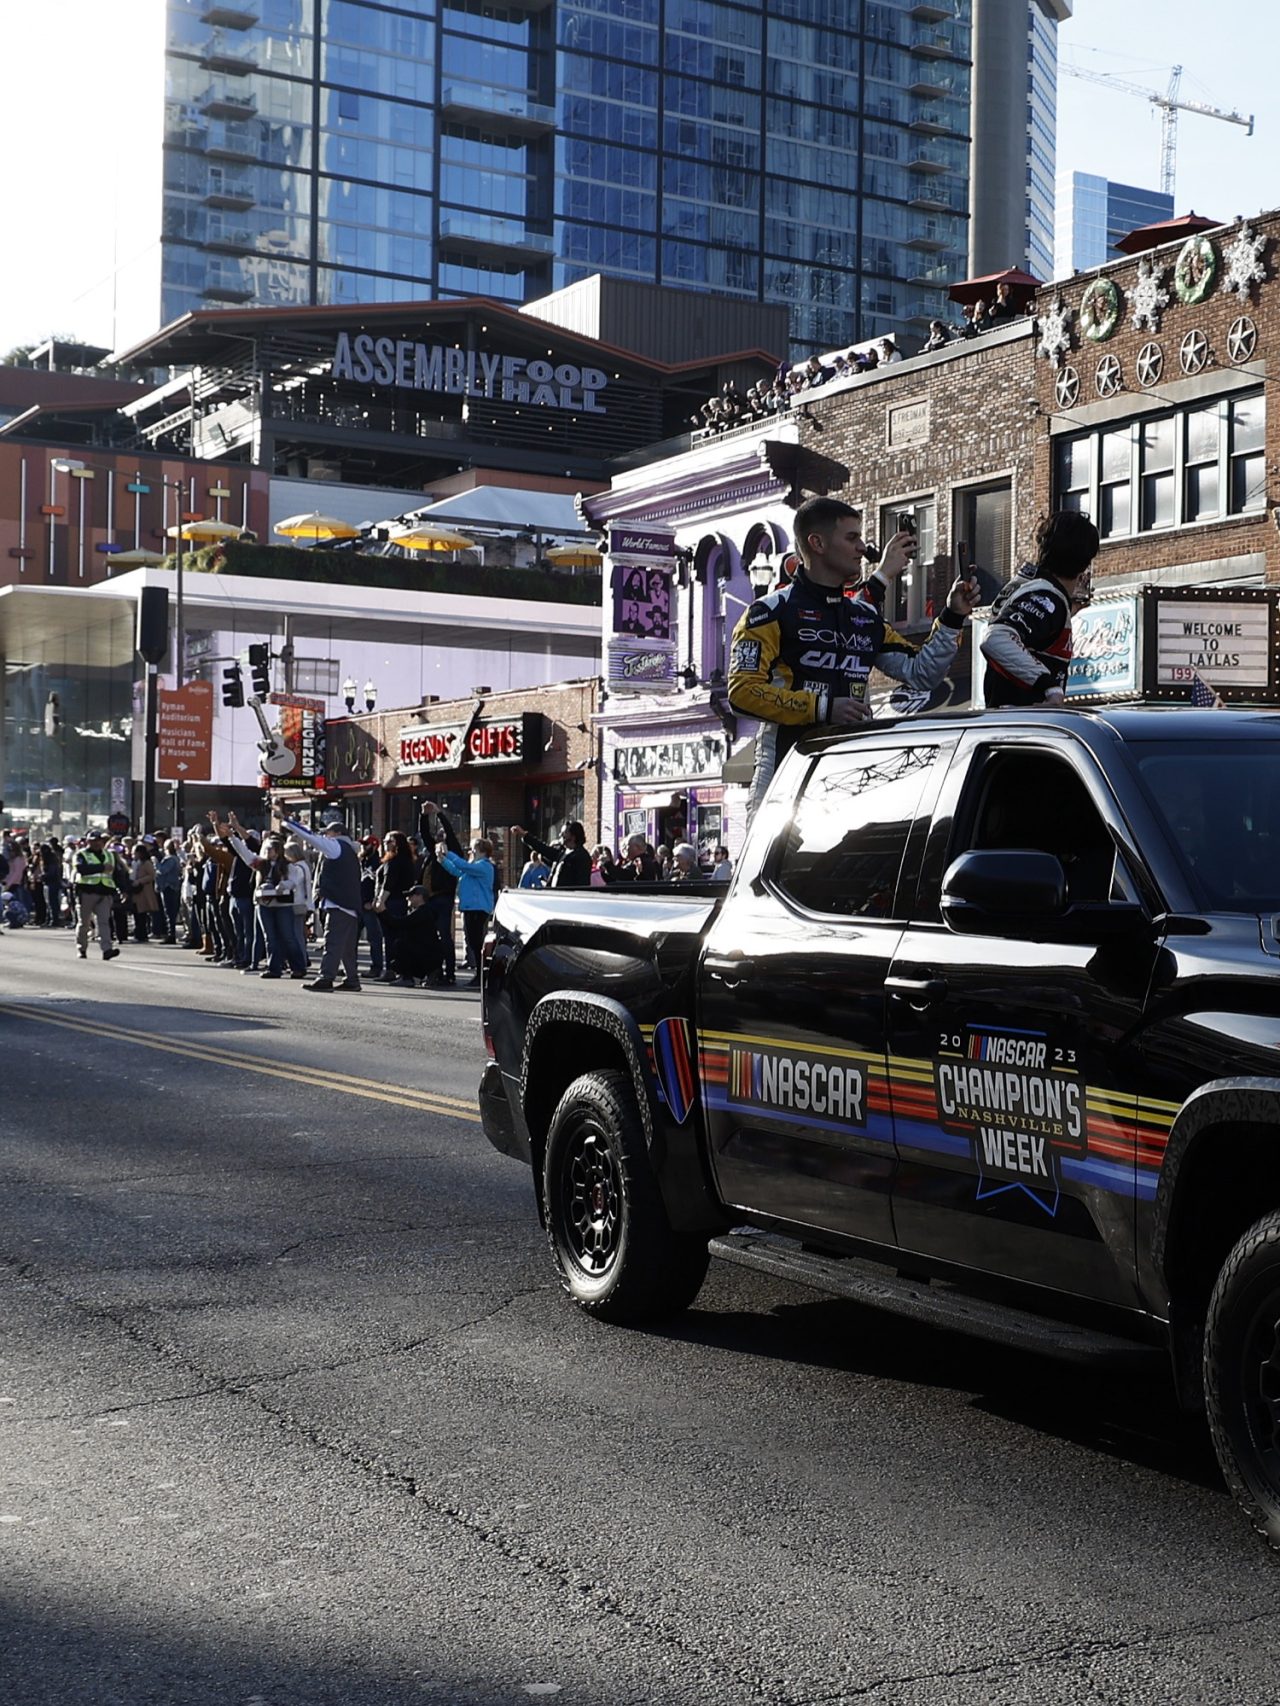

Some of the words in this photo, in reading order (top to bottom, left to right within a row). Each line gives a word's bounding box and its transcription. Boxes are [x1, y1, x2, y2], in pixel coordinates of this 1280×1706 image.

[331, 331, 500, 398] ASSEMBLY
[502, 355, 607, 390] FOOD
[502, 378, 607, 413] HALL
[1183, 622, 1243, 637] WELCOME
[1202, 638, 1219, 651] TO
[1189, 653, 1240, 667] LAYLAS
[1171, 668, 1194, 681] 199
[161, 702, 185, 711] Ryman
[161, 712, 201, 722] Auditorium
[161, 728, 196, 737] Musicians
[187, 739, 206, 748] Fame
[302, 709, 316, 777] LEGENDS
[470, 726, 515, 756] GIFTS
[167, 748, 197, 757] Museum
[939, 1033, 961, 1047] 20
[985, 1036, 1047, 1069] NASCAR
[1054, 1049, 1077, 1063] 23
[761, 1053, 863, 1121] NASCAR
[938, 1064, 1082, 1137] CHAMPION'S
[957, 1107, 1064, 1135] NASHVILLE
[980, 1126, 1049, 1177] WEEK
